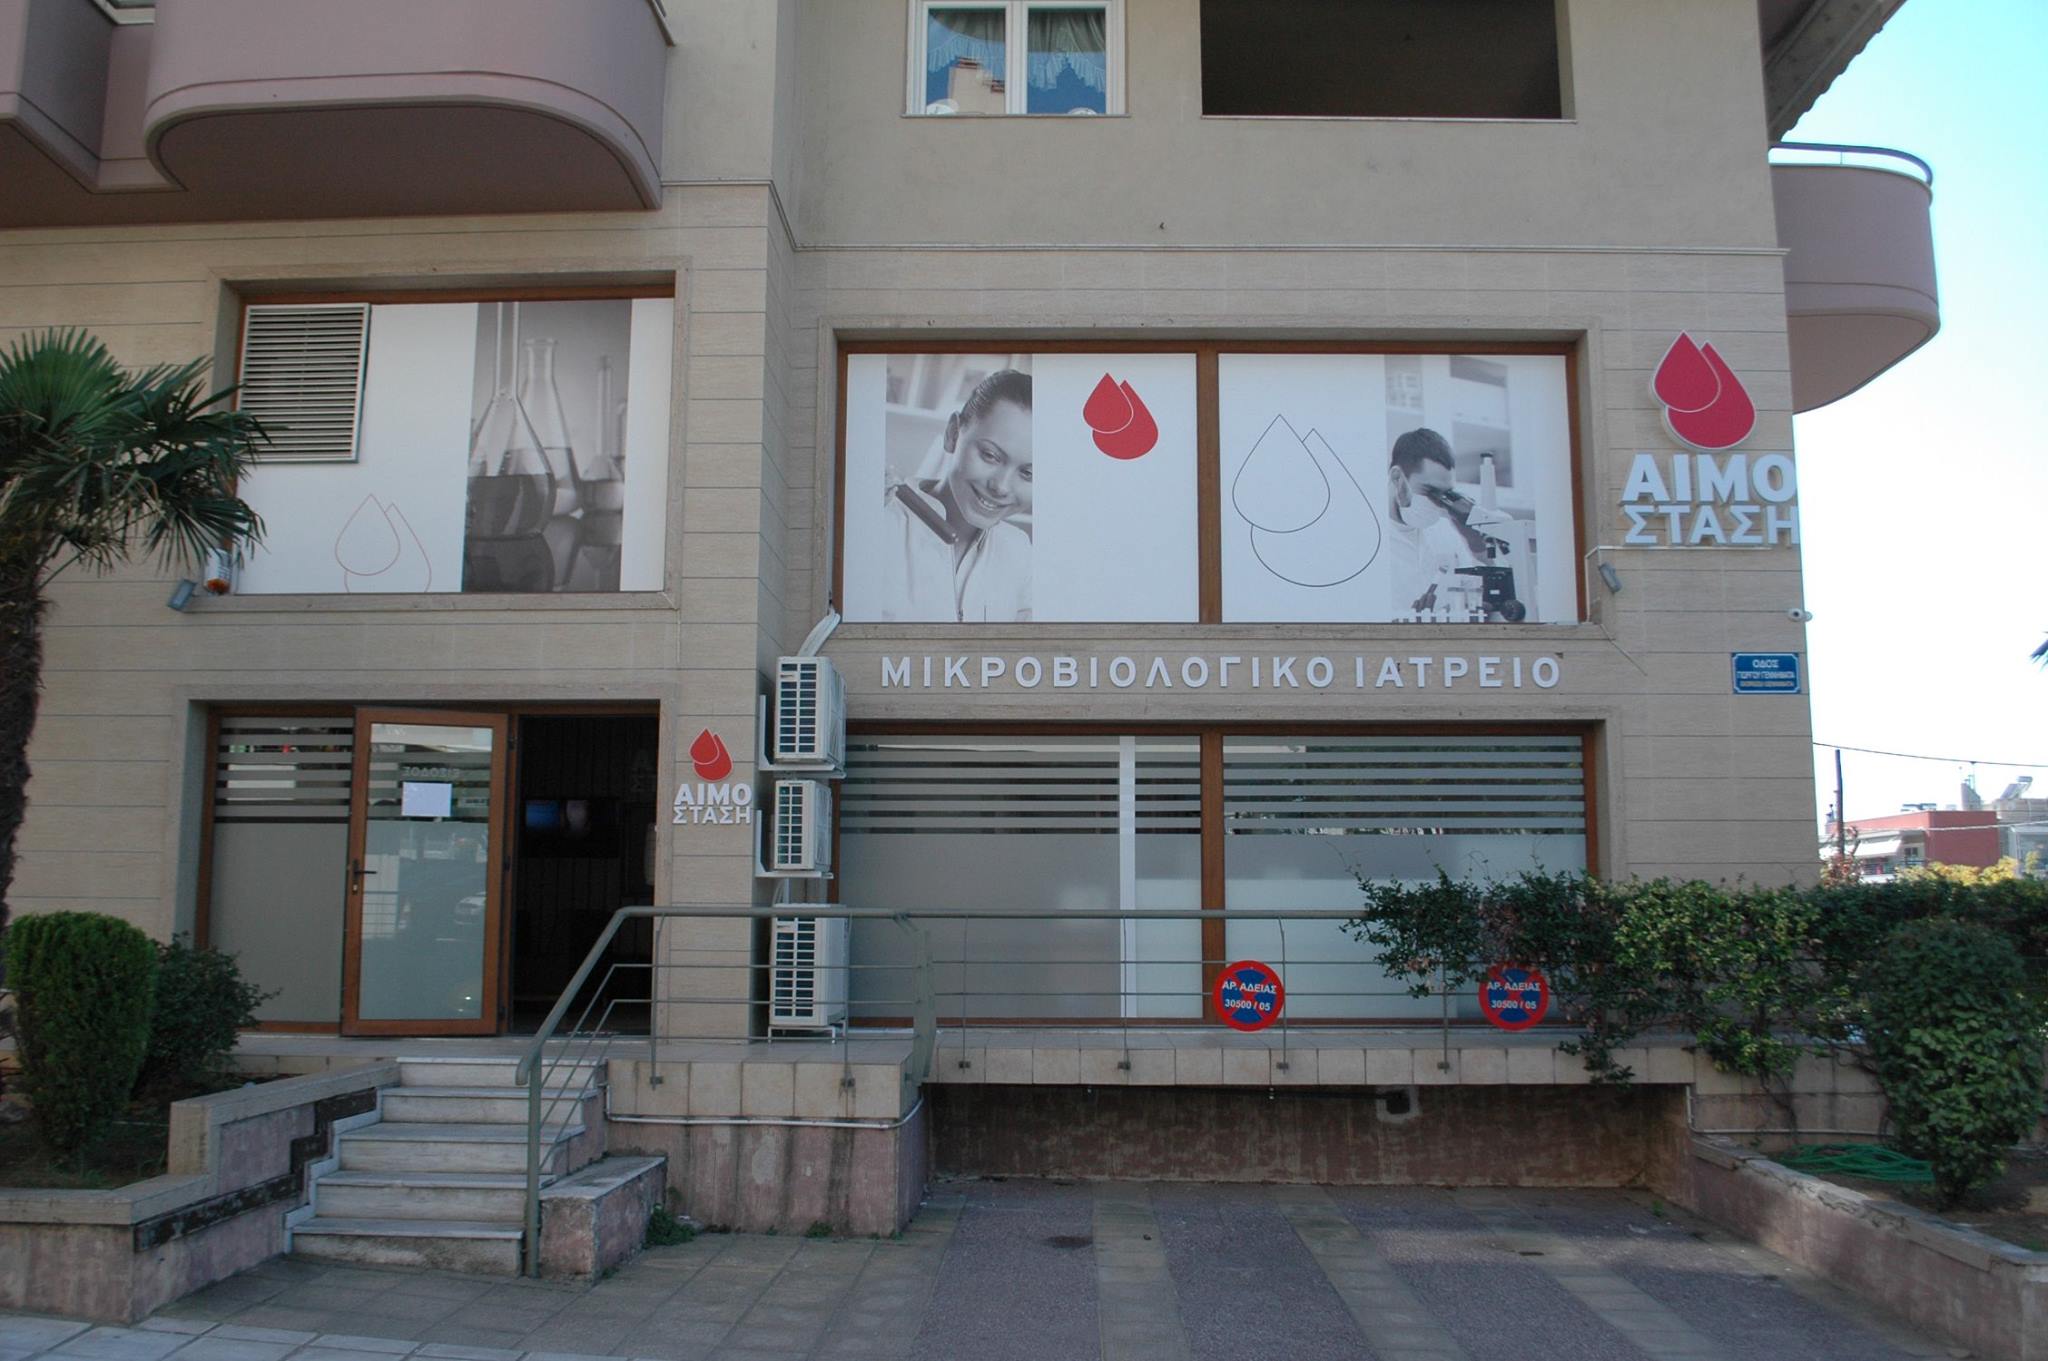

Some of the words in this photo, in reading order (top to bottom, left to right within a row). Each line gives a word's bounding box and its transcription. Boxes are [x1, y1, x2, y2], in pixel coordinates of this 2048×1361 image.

[1621, 453, 1797, 502] ΑΙΜΟ
[1623, 504, 1800, 544] ΣΤΑΣΗ
[881, 656, 1334, 688] ΜΙΚΡΟΒΙΟΛΟΓΙΚΟ
[1355, 656, 1560, 688] ΙΑΤΡΕΙΟ
[674, 783, 752, 806] ΑΙΜΟ
[672, 805, 751, 824] ΣΤΑΣΗ
[1222, 981, 1238, 991] ΑΡ.
[1239, 983, 1277, 994] ΑΔΕΙΑΣ
[1487, 982, 1503, 991] ΑΡ.
[1504, 982, 1541, 991] ΑΔΕΙΑΣ
[1224, 999, 1252, 1009] 30500
[1259, 1002, 1271, 1011] 05
